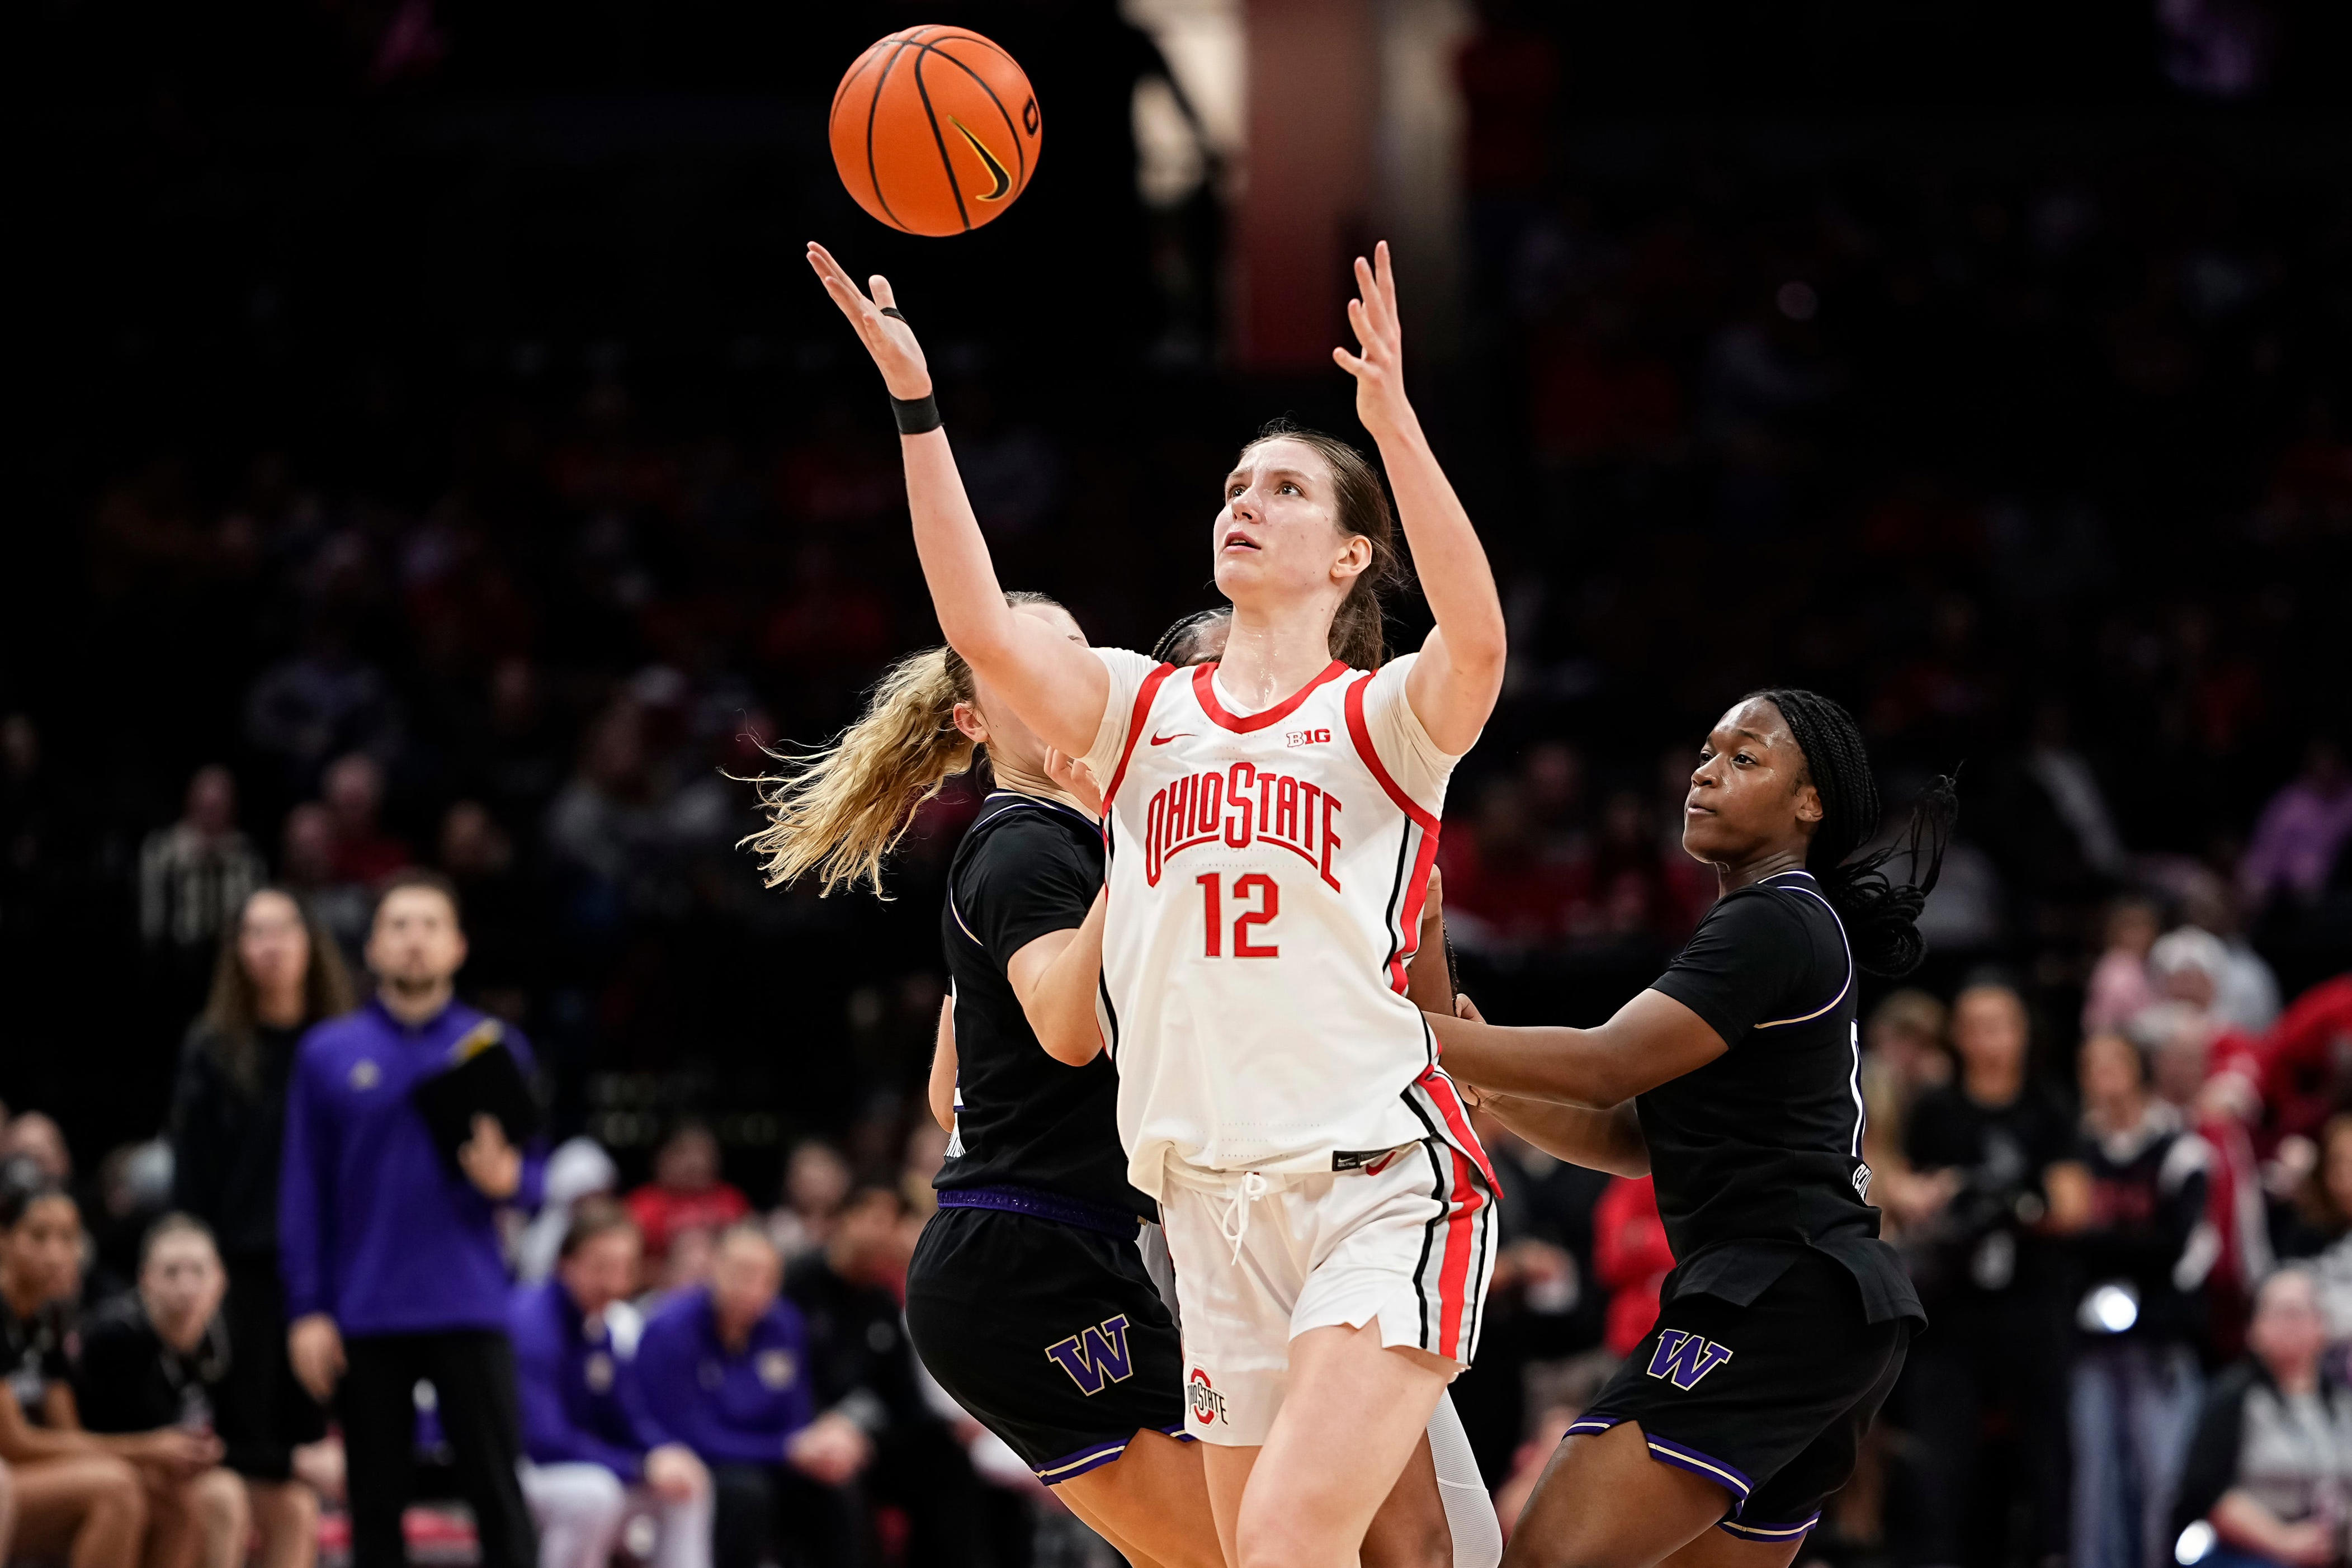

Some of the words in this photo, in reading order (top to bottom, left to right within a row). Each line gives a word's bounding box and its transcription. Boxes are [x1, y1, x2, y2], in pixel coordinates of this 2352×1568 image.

[1196, 871, 1279, 959] 12
[1045, 1314, 1133, 1396] W
[1646, 1329, 1734, 1391] W
